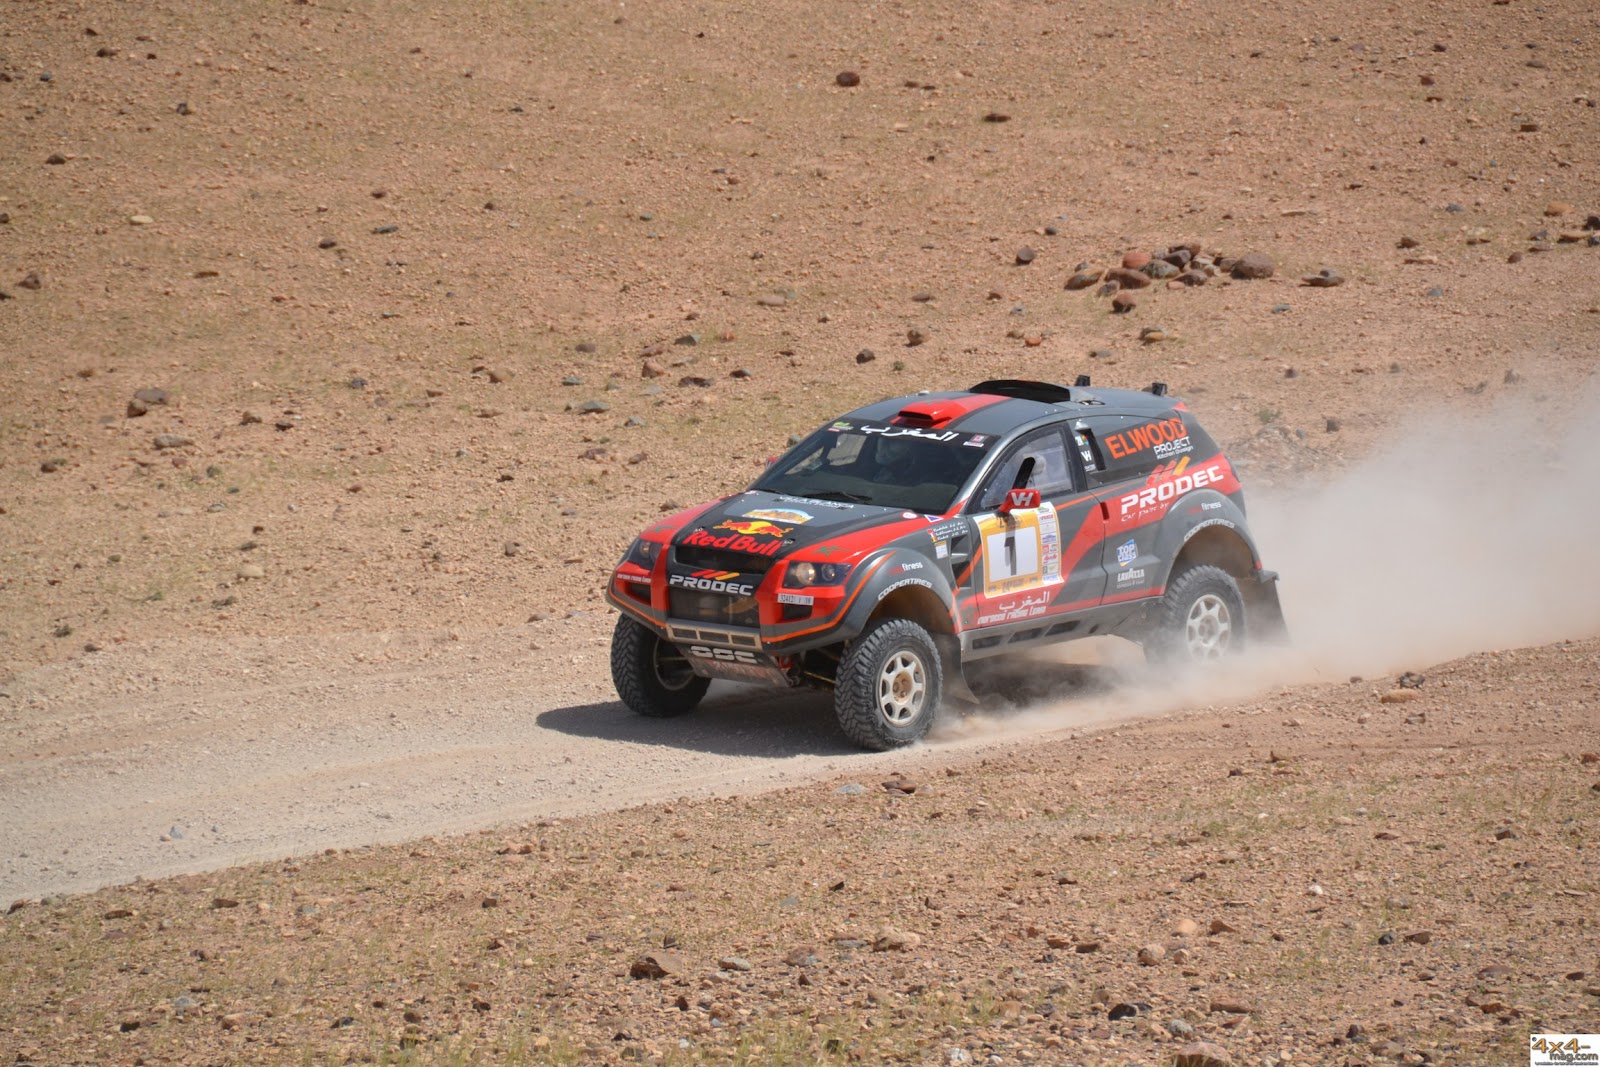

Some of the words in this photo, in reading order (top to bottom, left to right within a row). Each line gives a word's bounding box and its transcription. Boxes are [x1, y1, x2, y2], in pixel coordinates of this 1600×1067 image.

[860, 424, 960, 442] المغرب
[1105, 418, 1188, 459] ELWOOD
[1153, 436, 1191, 455] PROJECT
[1011, 492, 1034, 507] VH
[1121, 465, 1224, 515] PRODEC
[682, 530, 740, 546] Red
[729, 535, 783, 556] Bull
[1117, 544, 1136, 555] TOP
[1004, 536, 1017, 576] 1
[1117, 568, 1145, 582] LAVAZZA
[669, 574, 754, 597] PRODEC
[998, 593, 1050, 613] المغرب
